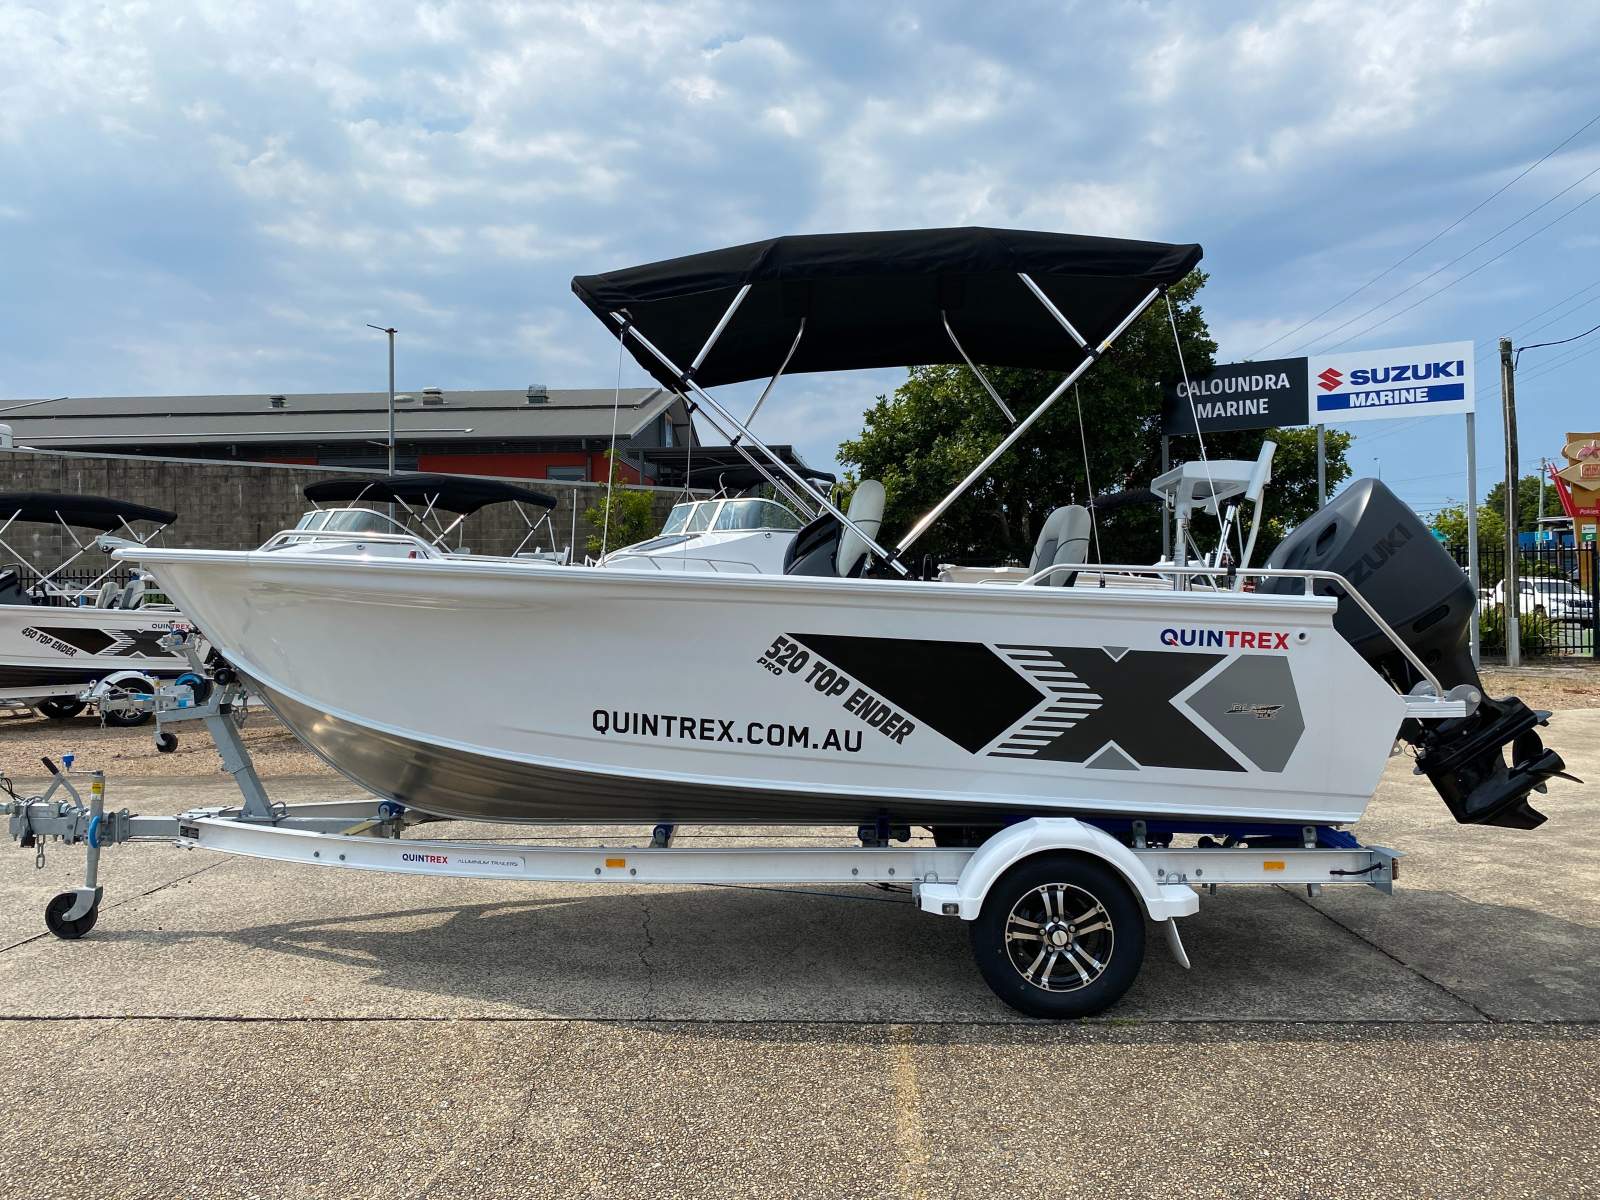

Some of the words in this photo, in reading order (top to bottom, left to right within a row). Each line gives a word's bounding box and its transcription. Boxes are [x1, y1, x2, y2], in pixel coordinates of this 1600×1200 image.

[1350, 360, 1465, 386] SUZUKI
[1176, 373, 1291, 398] CALOUNDRA
[1197, 398, 1269, 419] MARINE
[1350, 388, 1429, 407] MARINE
[151, 623, 190, 631] QUINTREX
[22, 627, 38, 639] 450
[35, 633, 54, 645] TOP
[50, 640, 78, 657] ENDER
[1160, 628, 1290, 650] QUINTREX
[756, 656, 783, 676] PRO
[764, 635, 810, 674] 520
[804, 660, 850, 697] TOP
[842, 687, 916, 745] ENDER
[592, 709, 863, 753] QUINTREX.COM.AU
[402, 853, 448, 864] QUINTREX
